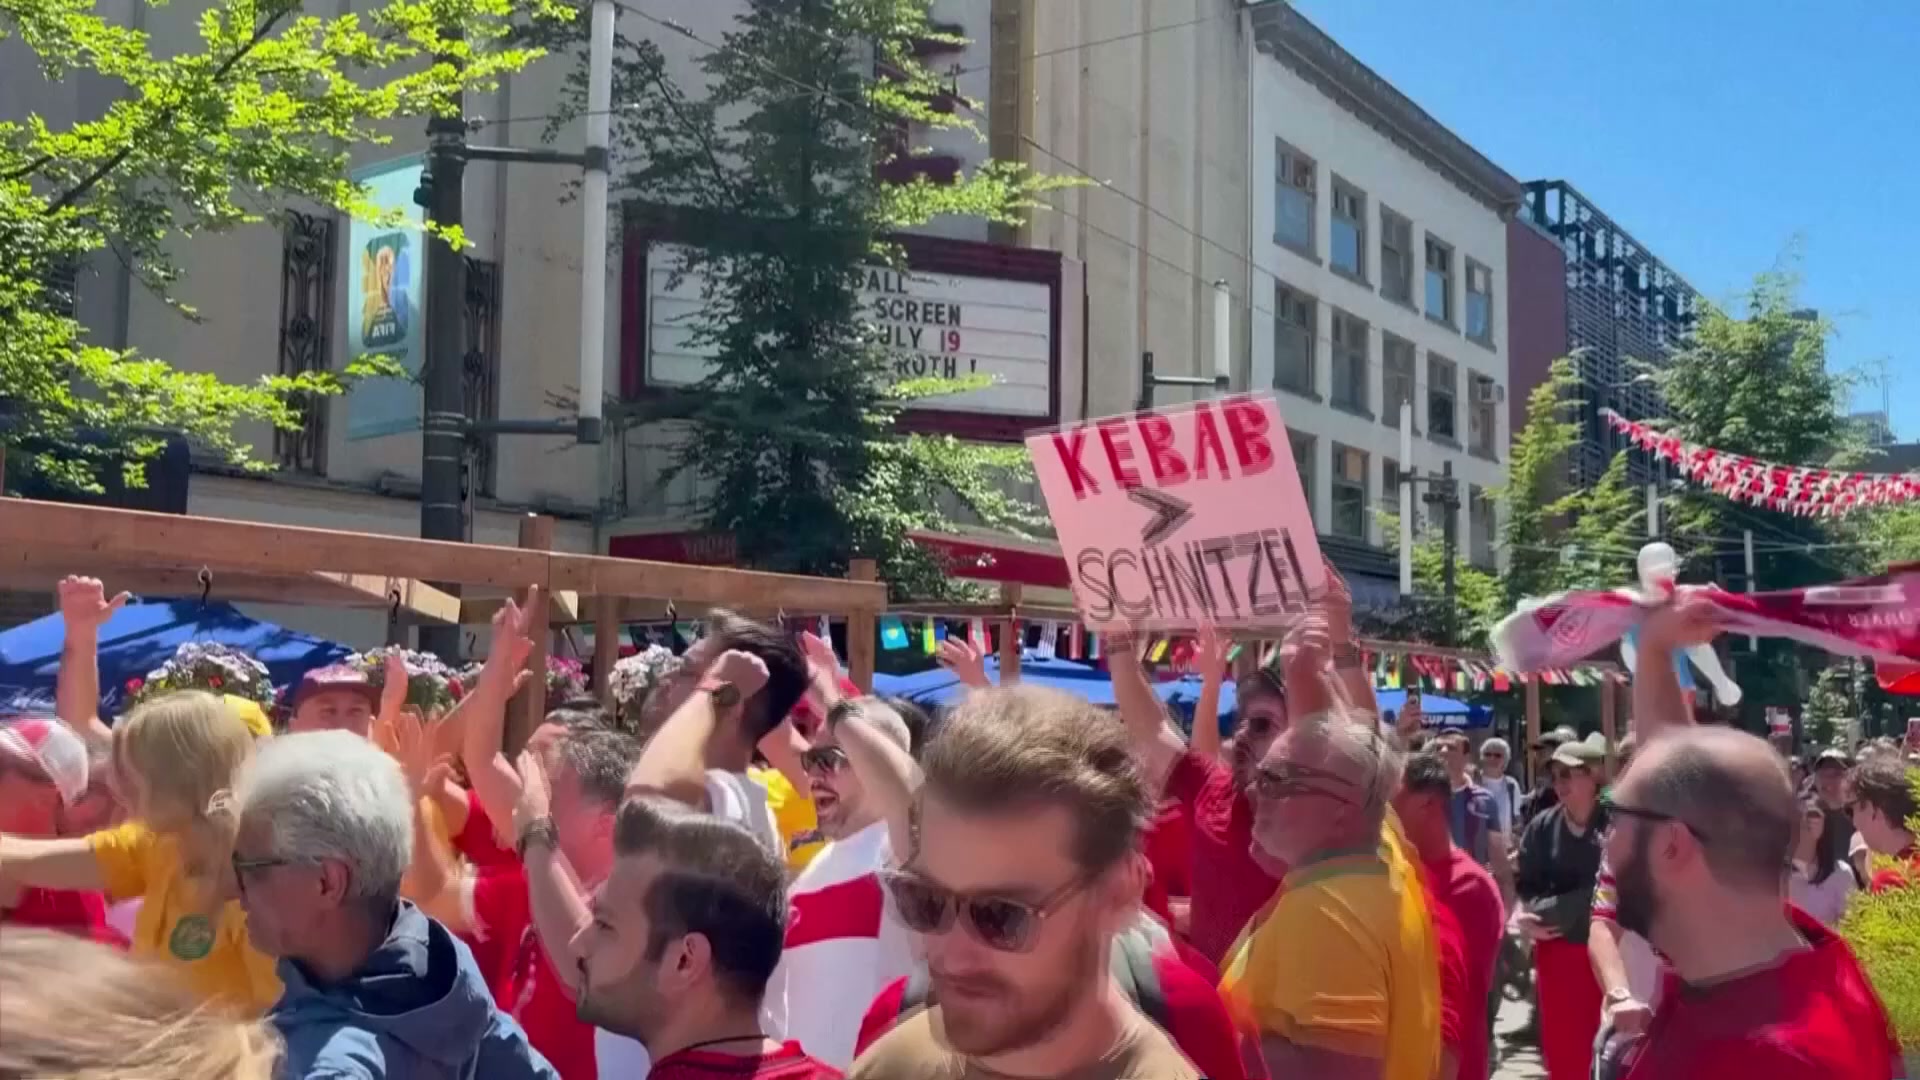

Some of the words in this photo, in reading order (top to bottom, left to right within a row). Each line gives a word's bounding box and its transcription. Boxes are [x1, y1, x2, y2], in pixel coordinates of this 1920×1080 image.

[875, 298, 961, 327] SCREEN
[940, 329, 961, 353] 19
[1052, 397, 1274, 500] KEBAB
[1076, 527, 1321, 621] SCHNITZEL
